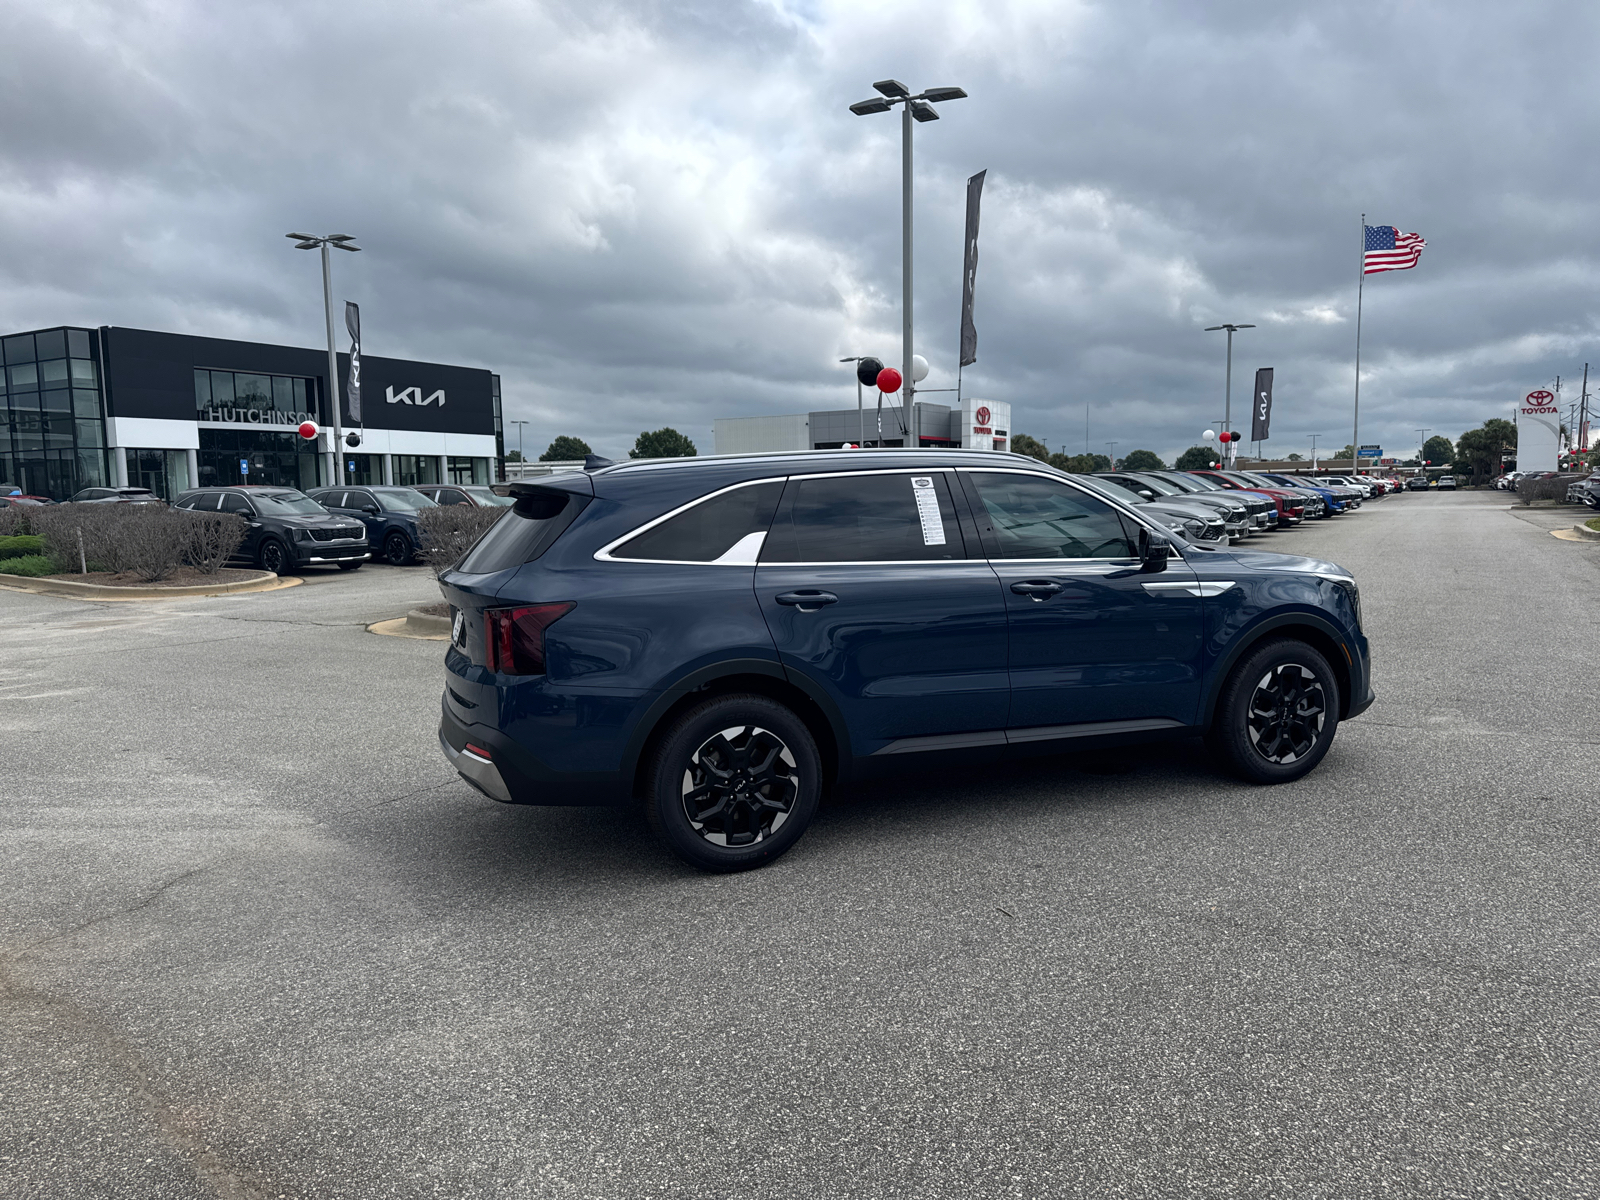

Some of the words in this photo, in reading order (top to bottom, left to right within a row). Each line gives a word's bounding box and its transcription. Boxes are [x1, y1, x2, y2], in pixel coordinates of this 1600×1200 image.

[385, 385, 446, 408] KIA
[1259, 391, 1268, 421] KIA
[208, 406, 319, 426] HUTCHINSON
[1521, 406, 1558, 415] TOYOTA
[973, 427, 992, 435] TOYOTA
